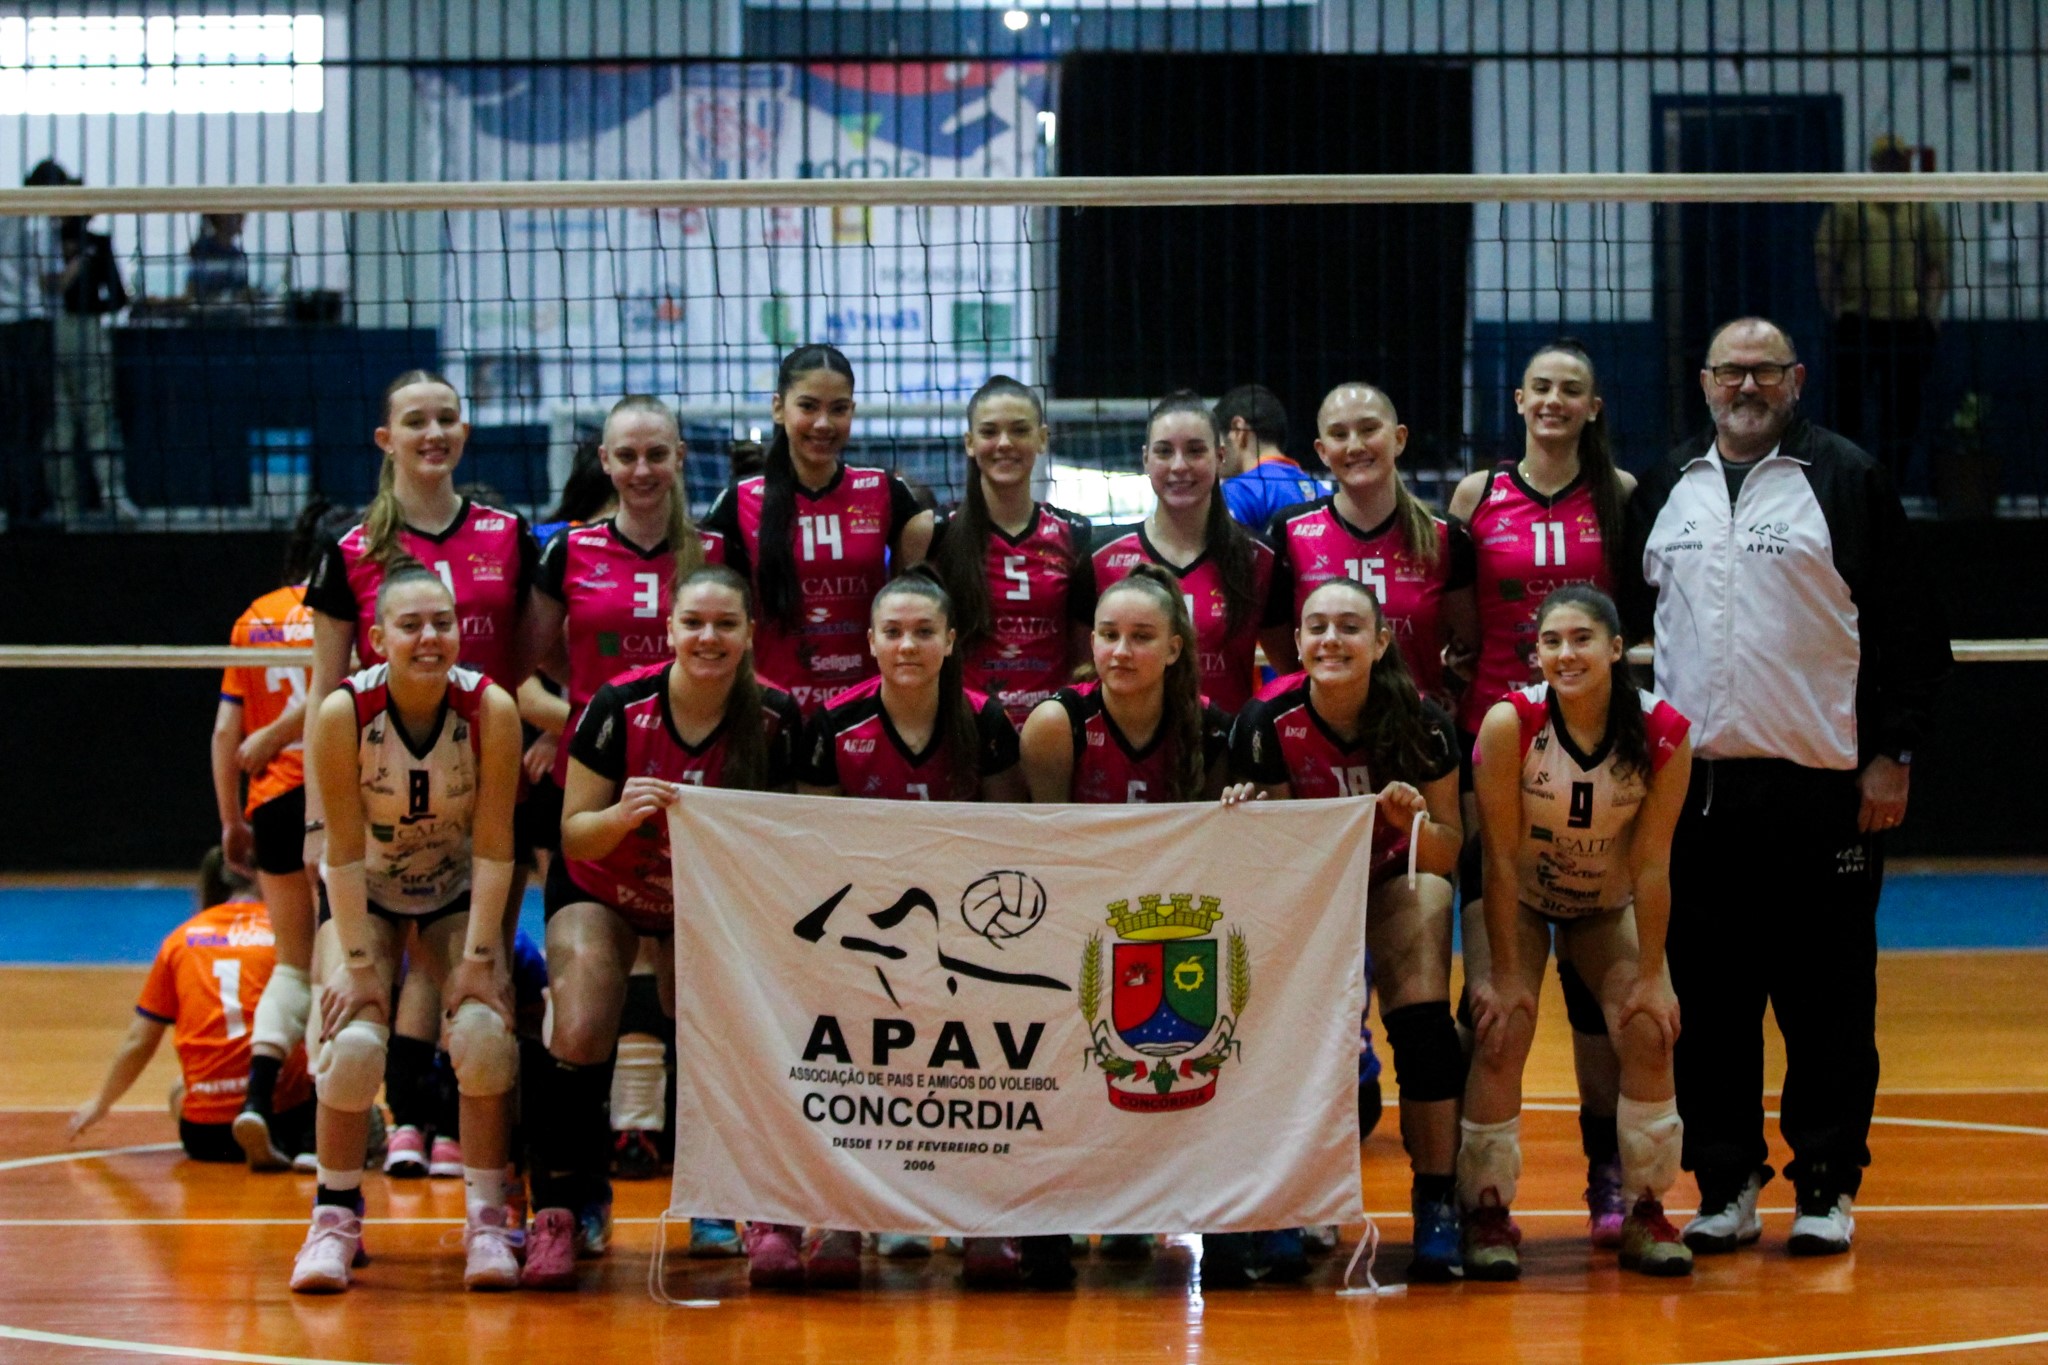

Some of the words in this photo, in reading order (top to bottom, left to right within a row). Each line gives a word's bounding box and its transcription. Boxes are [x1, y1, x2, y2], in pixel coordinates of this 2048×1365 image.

[798, 514, 843, 561] 14
[1530, 522, 1566, 566] 11
[1746, 543, 1785, 555] APAV
[633, 573, 659, 618] 3
[1004, 555, 1031, 600] 5
[1567, 781, 1594, 829] 9
[1837, 864, 1865, 874] APAV
[212, 959, 247, 1040] 1
[801, 1014, 1047, 1070] APAV
[789, 1066, 865, 1087] ASSOCIAÇÃO
[868, 1072, 884, 1086] DE
[887, 1073, 913, 1087] PAIS
[917, 1074, 924, 1087] E
[928, 1074, 975, 1089] AMIGOS
[979, 1076, 996, 1090] DO
[999, 1077, 1060, 1091] VOLEIBOL
[802, 1090, 1044, 1131] CONCÓRDIA
[833, 1137, 872, 1149] DESDE
[877, 1139, 892, 1150] 17
[896, 1140, 913, 1151] DE
[916, 1140, 989, 1154] FEVEREIRO
[992, 1143, 1010, 1154] DE
[903, 1160, 936, 1172] 2006
